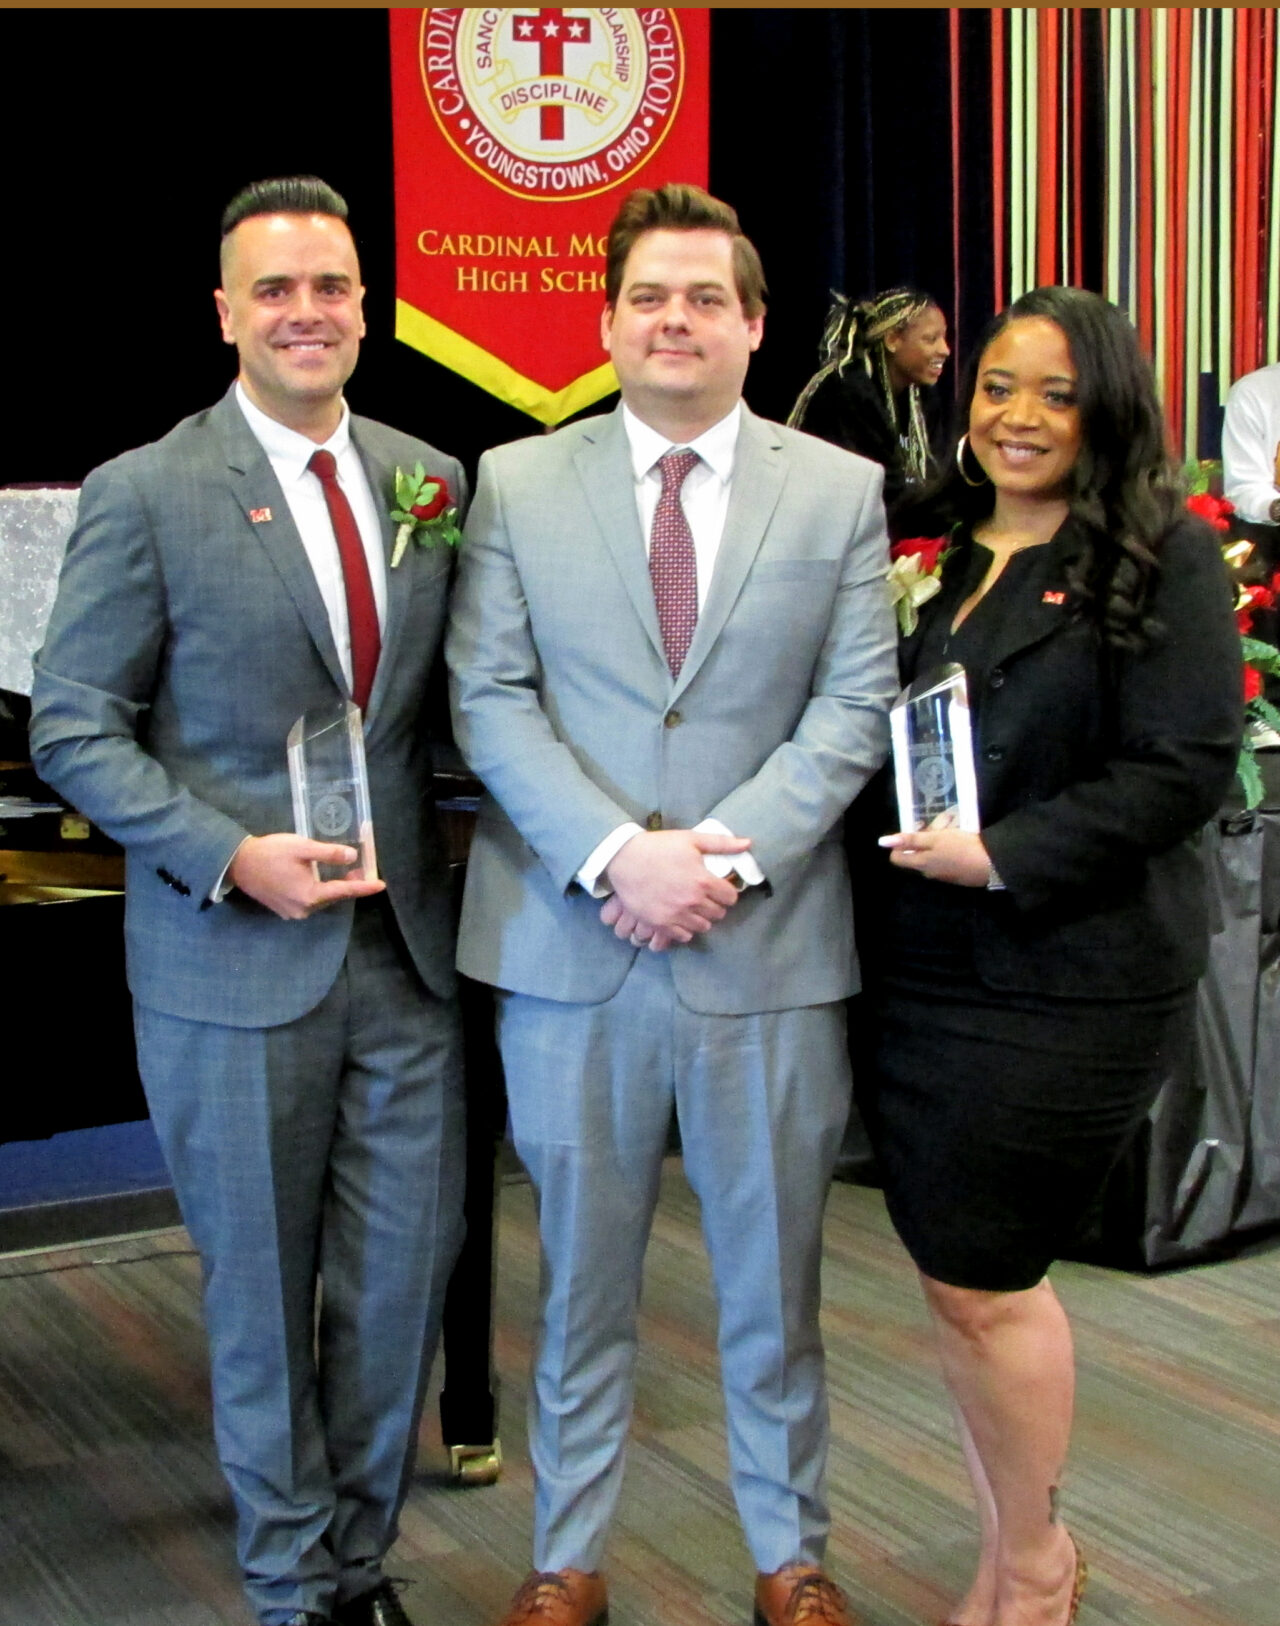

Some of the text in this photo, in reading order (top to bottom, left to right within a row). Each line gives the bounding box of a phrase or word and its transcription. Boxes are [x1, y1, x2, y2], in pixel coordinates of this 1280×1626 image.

[477, 8, 503, 69] SANC
[641, 8, 676, 117] SCHOOL
[500, 83, 608, 113] DISCIPLINE
[465, 124, 651, 190] YOUNGSTOWN, OHIO
[417, 229, 560, 257] CARDINAL
[456, 266, 528, 292] HIGH
